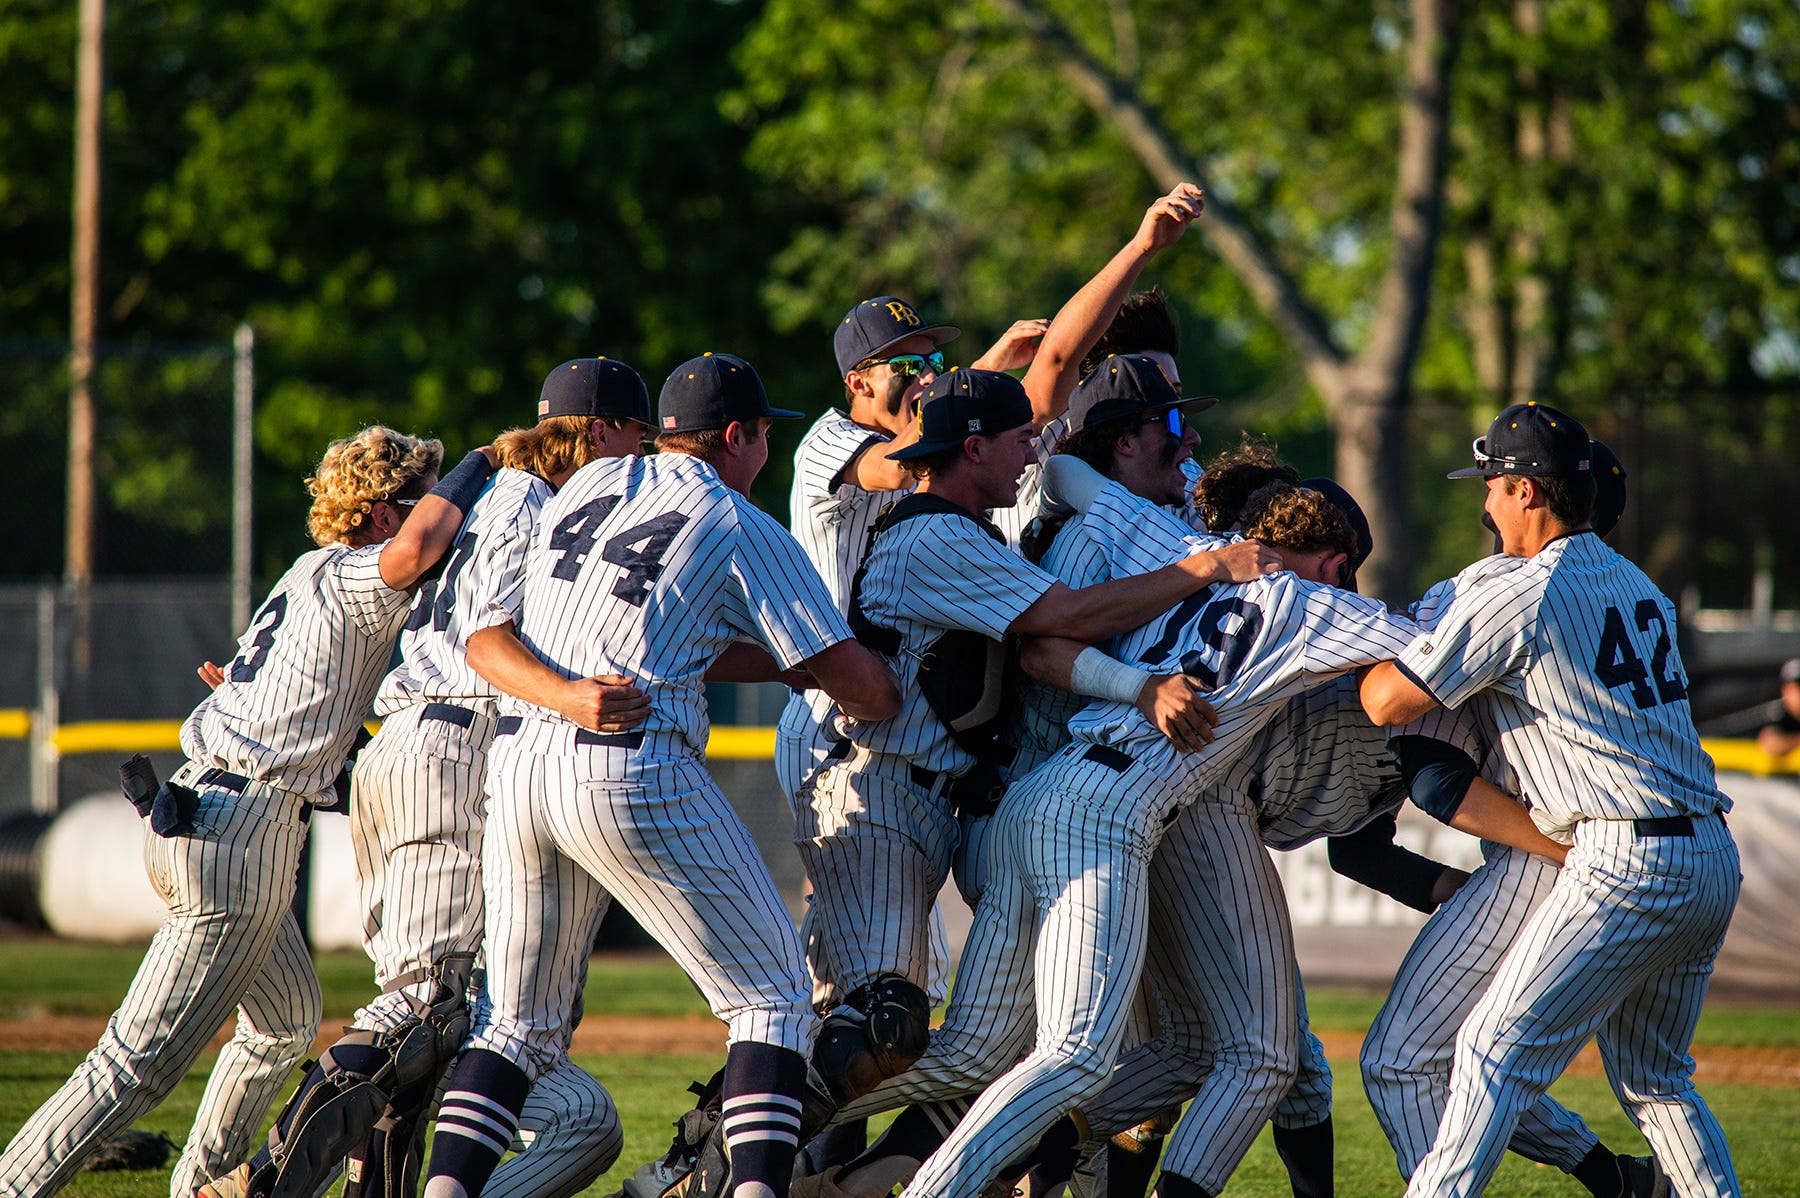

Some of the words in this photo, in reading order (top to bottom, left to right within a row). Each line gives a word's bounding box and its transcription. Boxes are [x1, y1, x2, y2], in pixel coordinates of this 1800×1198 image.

[549, 494, 691, 608] 44
[231, 591, 288, 682] 3
[1594, 599, 1687, 709] 42
